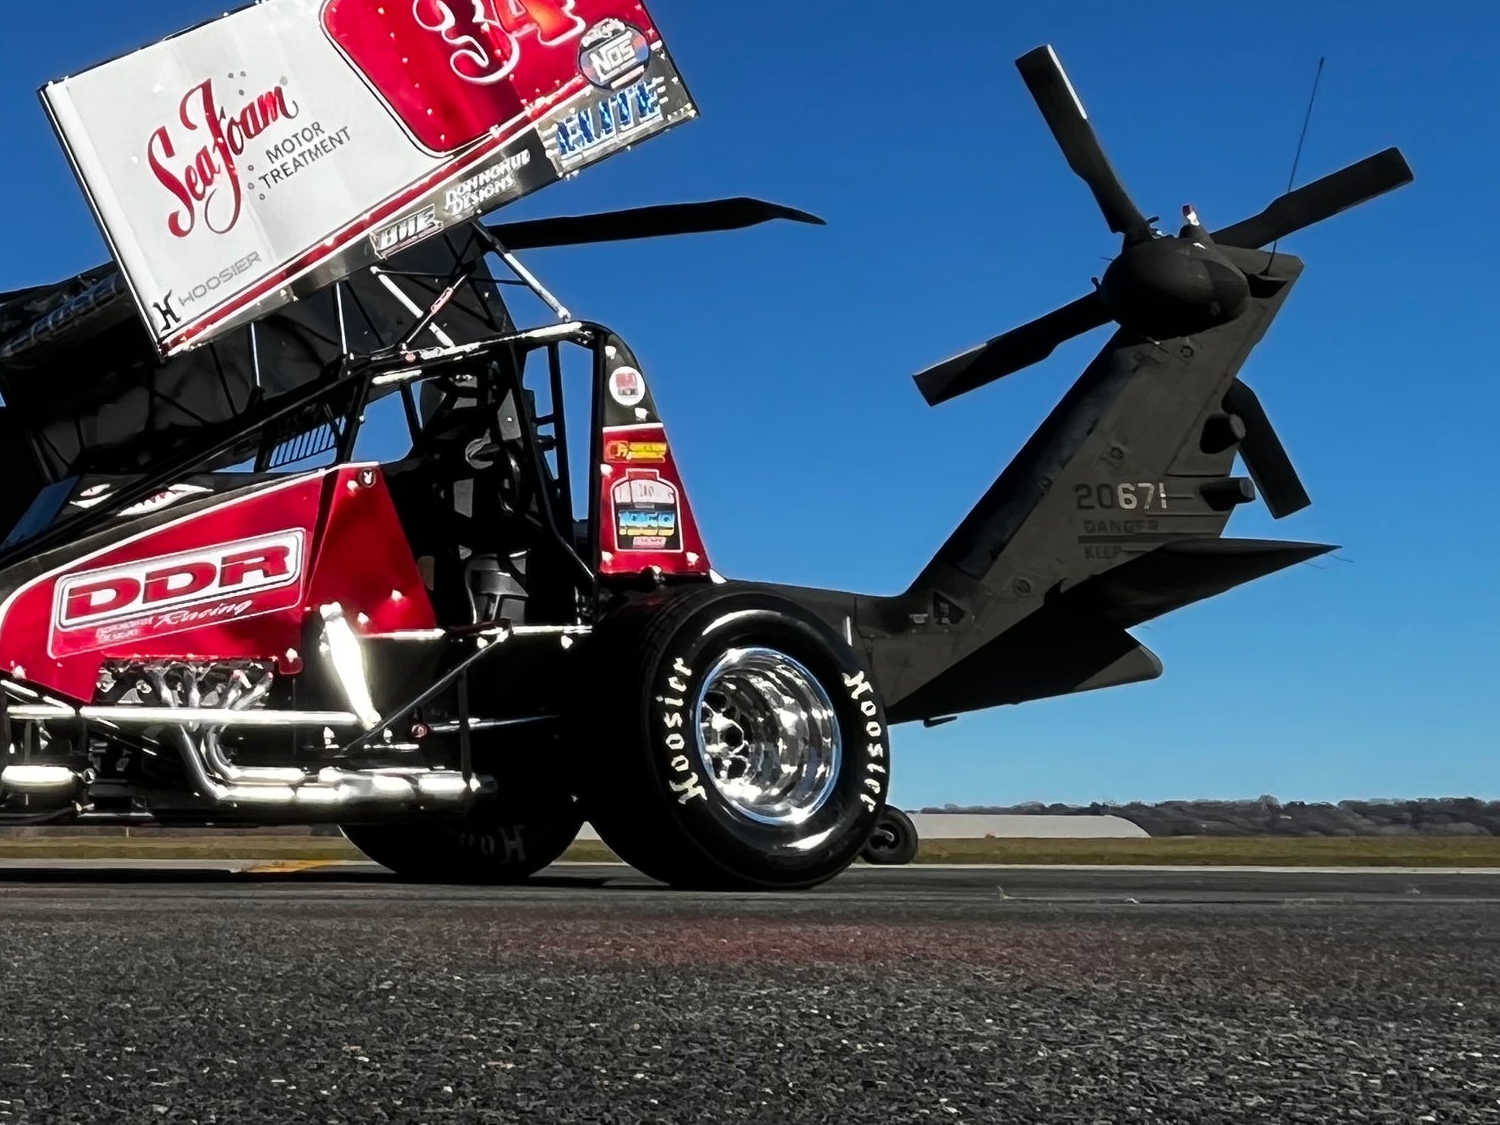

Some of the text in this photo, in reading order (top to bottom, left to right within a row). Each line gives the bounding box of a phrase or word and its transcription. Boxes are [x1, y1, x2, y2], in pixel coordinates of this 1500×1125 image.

[589, 31, 636, 83] NOS
[258, 126, 352, 190] TREATMENT
[265, 121, 326, 165] MOTOR
[178, 251, 263, 307] HOOSIER
[1074, 482, 1168, 510] 20671
[1083, 519, 1160, 534] DANGER
[65, 545, 290, 620] DDR
[153, 600, 253, 629] Racing
[655, 657, 708, 805] Hoosier
